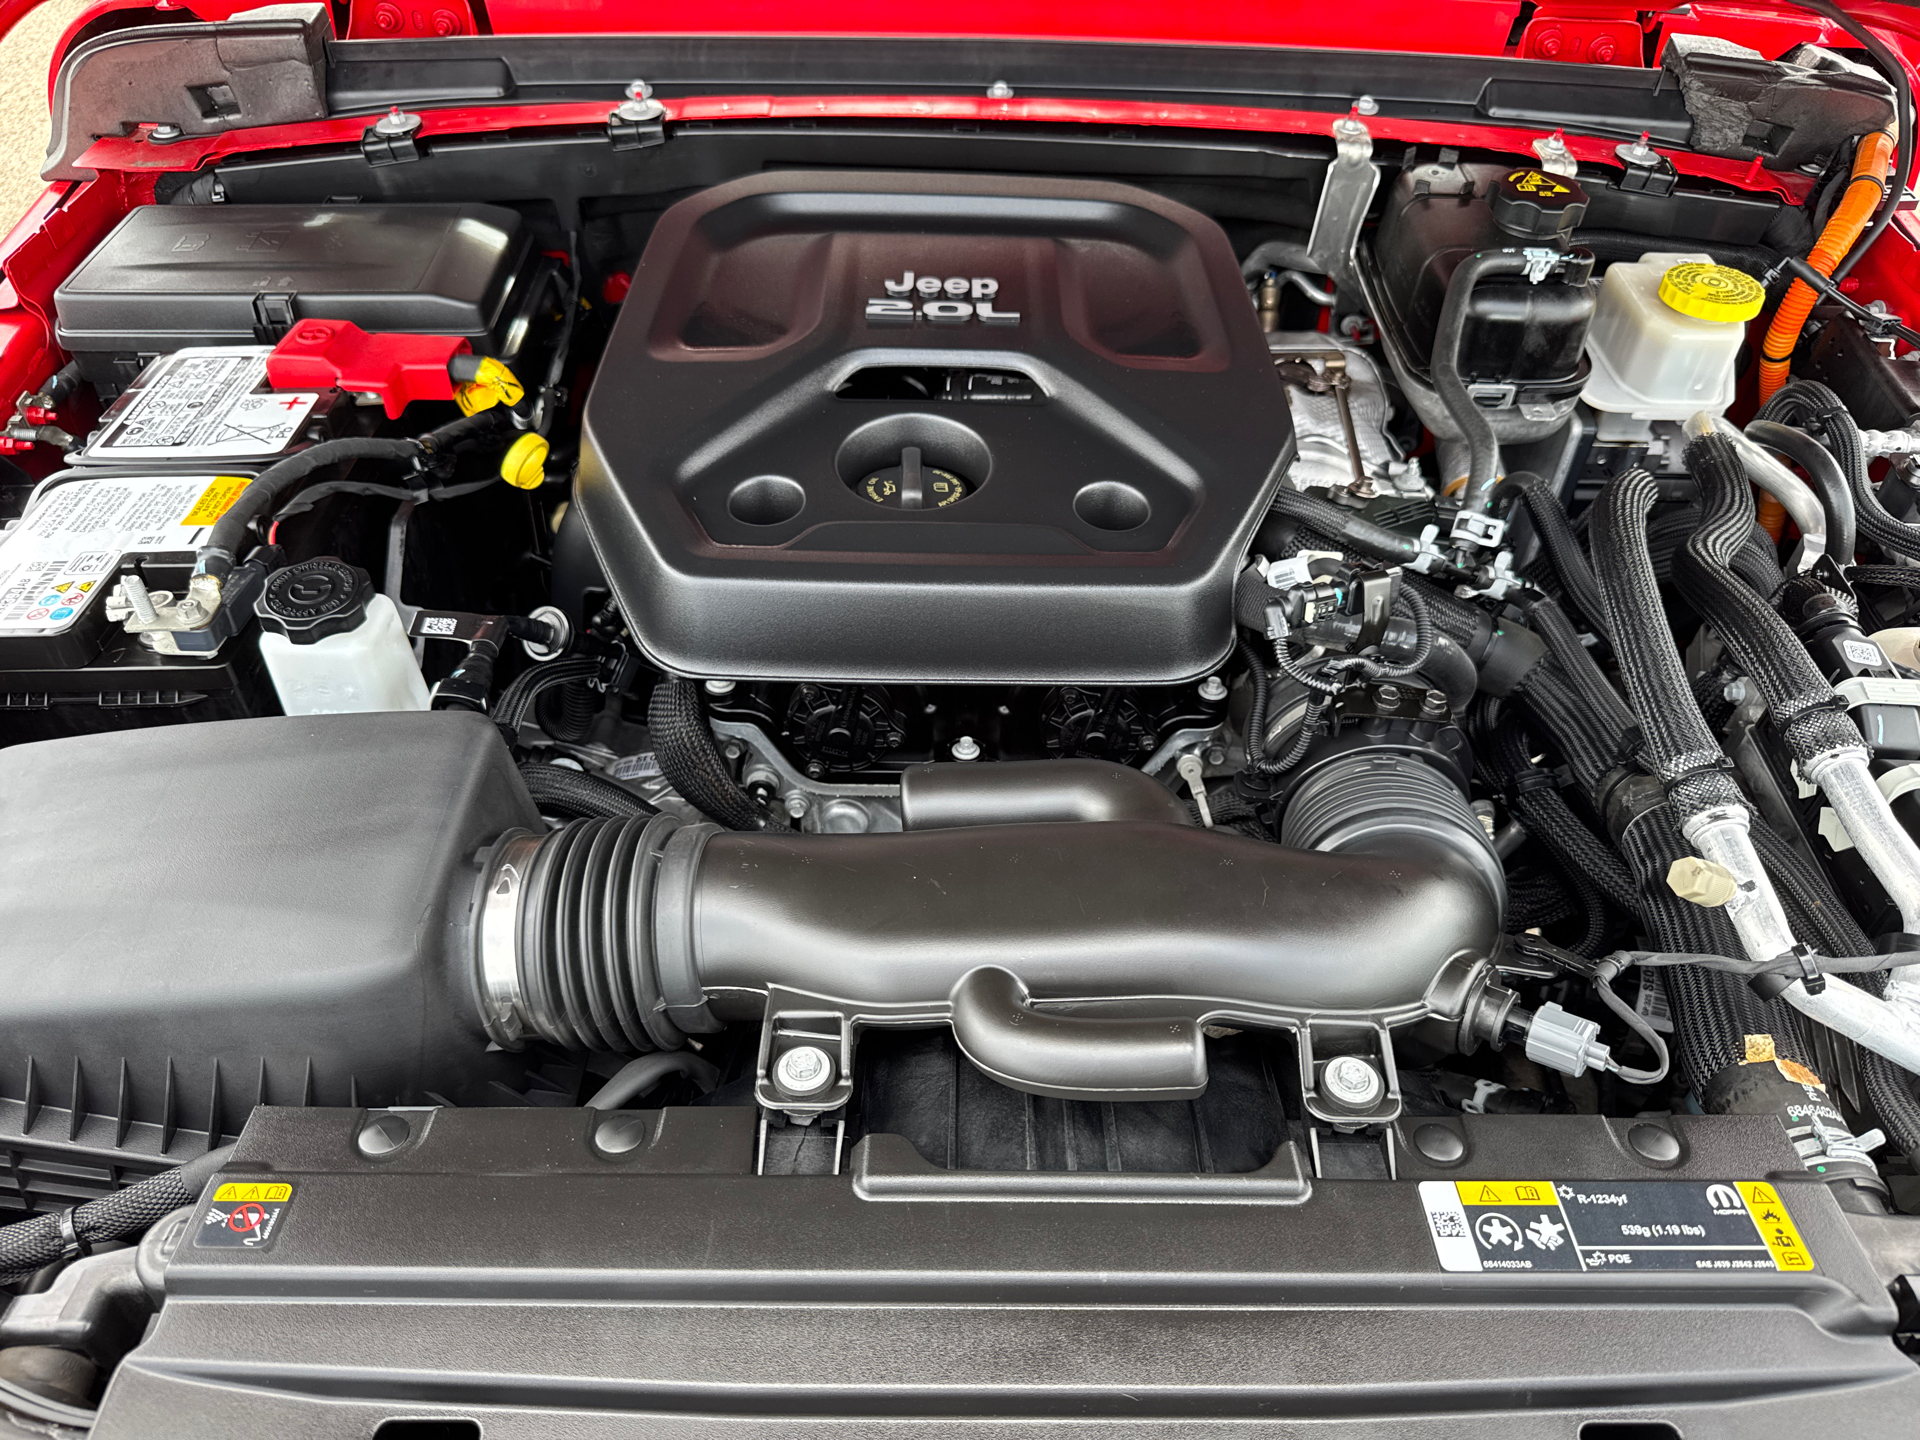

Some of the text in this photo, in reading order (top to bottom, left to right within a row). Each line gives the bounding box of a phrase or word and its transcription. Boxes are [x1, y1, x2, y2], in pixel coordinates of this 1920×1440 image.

[884, 270, 999, 299] Jeep
[865, 298, 1021, 322] 2.0L
[866, 477, 884, 503] ENGINE OIL
[202, 492, 221, 511] BATTERY
[206, 510, 216, 518] DO
[1577, 1193, 1628, 1206] R-1234yf
[1621, 1224, 1706, 1237] 539g (1.19 lbs)
[1608, 1254, 1632, 1264] POE
